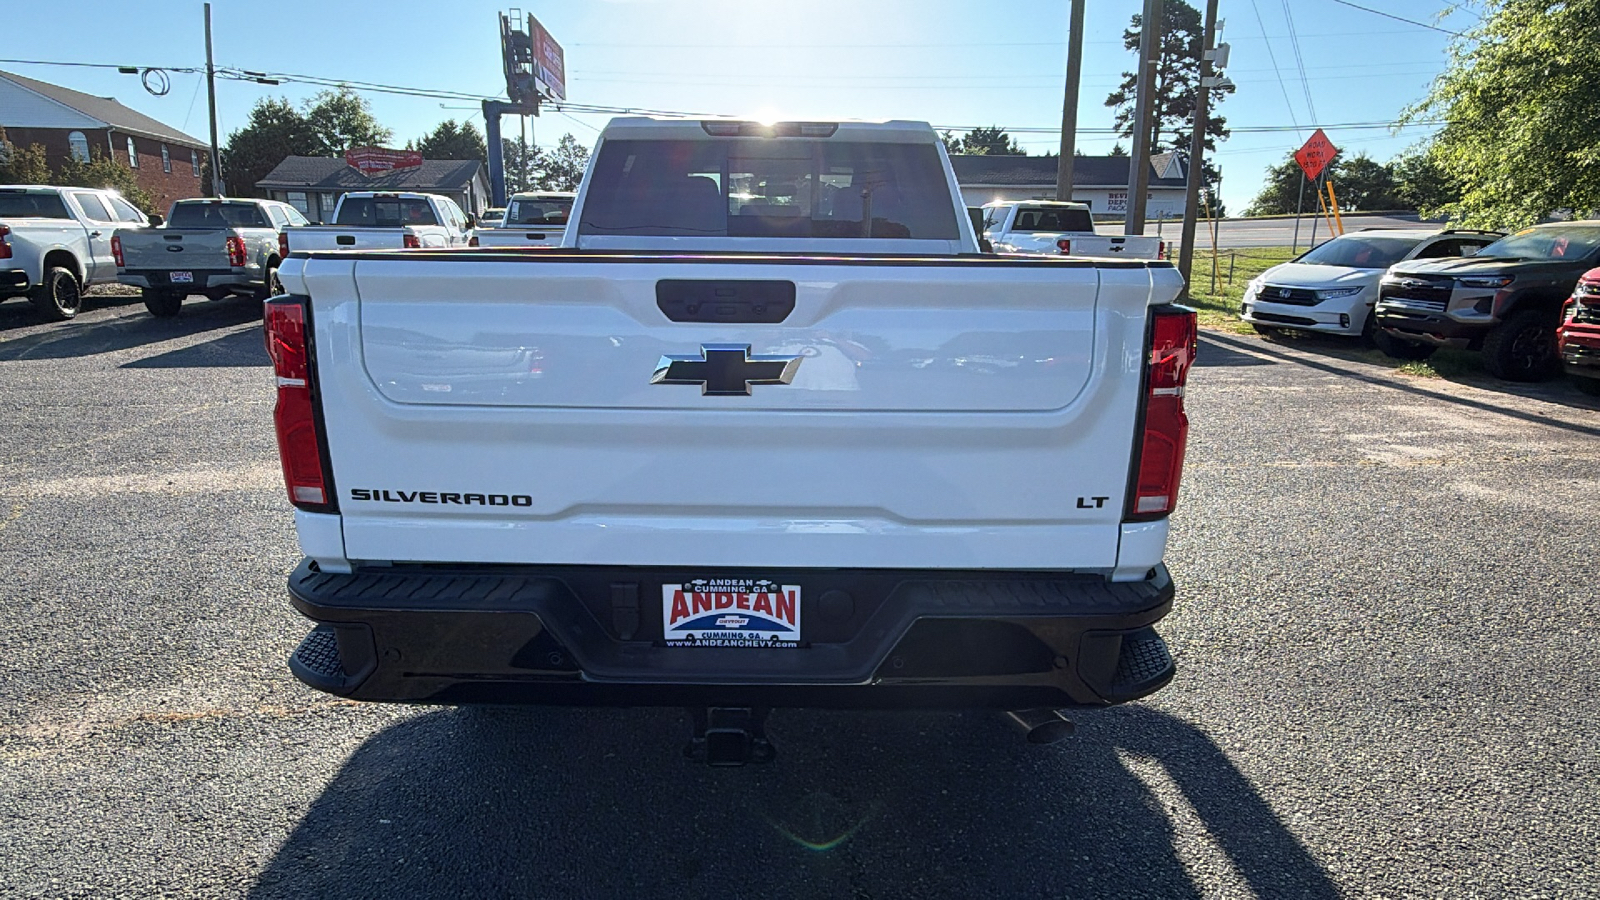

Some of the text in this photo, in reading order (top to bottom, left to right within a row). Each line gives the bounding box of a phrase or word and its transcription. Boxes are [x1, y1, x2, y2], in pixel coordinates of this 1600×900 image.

[1308, 141, 1325, 149] ROAD
[1306, 151, 1324, 159] WORK
[351, 488, 533, 507] SILVERADO
[1076, 496, 1110, 509] LT
[669, 589, 796, 627] ANDEAN
[701, 632, 764, 640] CUMMING, GA.
[666, 639, 798, 648] www.ANDEANCHEVY.com
